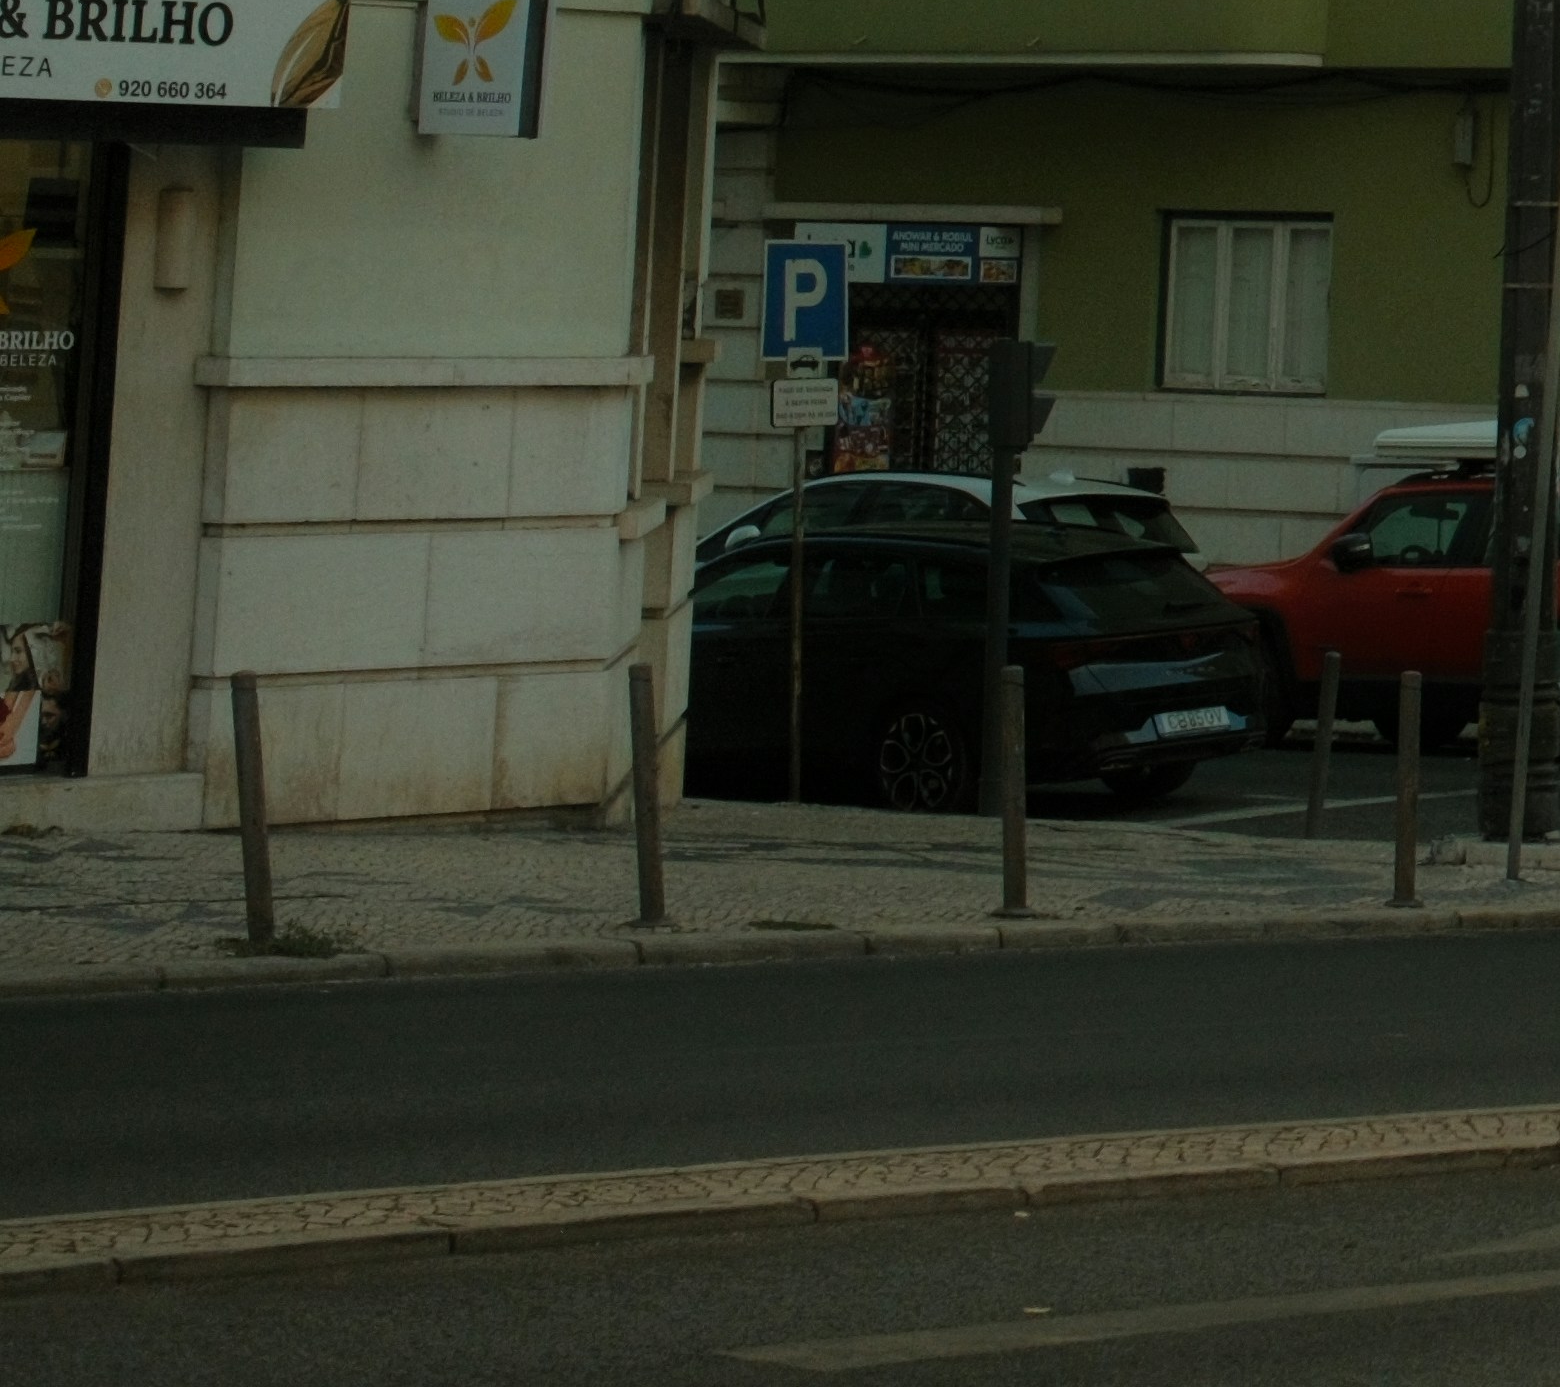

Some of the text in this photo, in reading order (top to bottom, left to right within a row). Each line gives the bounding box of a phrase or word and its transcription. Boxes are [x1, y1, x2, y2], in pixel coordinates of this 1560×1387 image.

[119, 81, 227, 99] 920 660 364
[433, 91, 512, 104] BELEZA & BRILHO
[900, 242, 964, 253] MINI MERCADO
[783, 258, 828, 342] P
[0, 330, 75, 350] BRILHO
[0, 354, 57, 367] BELEZA
